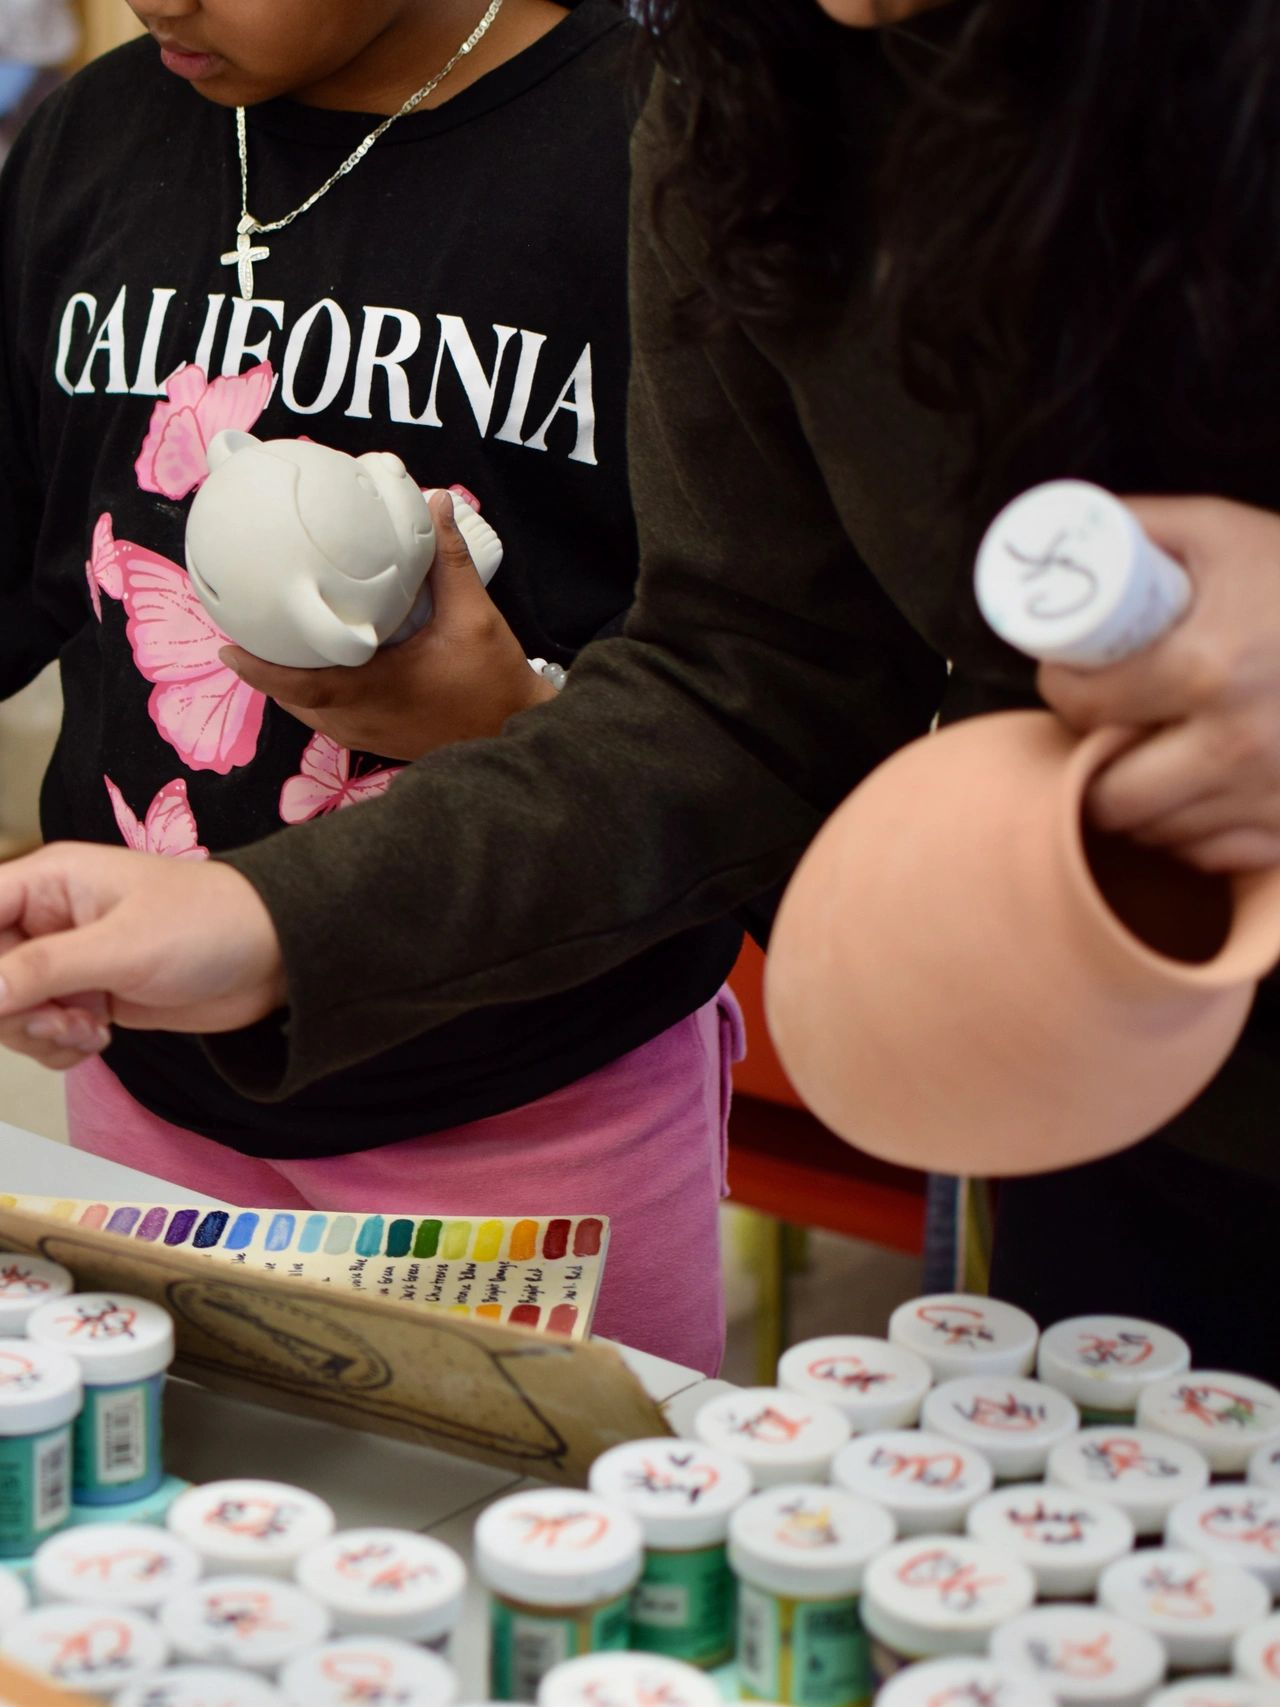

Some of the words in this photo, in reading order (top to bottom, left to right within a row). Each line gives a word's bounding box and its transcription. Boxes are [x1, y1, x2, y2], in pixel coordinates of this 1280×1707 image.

[54, 284, 599, 466] CALIFORNIA
[348, 1258, 368, 1271] Blue
[402, 1263, 421, 1282] Green
[458, 1262, 477, 1281] Yellow
[488, 1261, 518, 1281] Orange
[564, 1265, 583, 1280] Red
[377, 1265, 396, 1285] Green
[524, 1268, 543, 1281] Red
[454, 1284, 472, 1304] ntense
[481, 1284, 507, 1303] Bright
[518, 1284, 546, 1303] Bright
